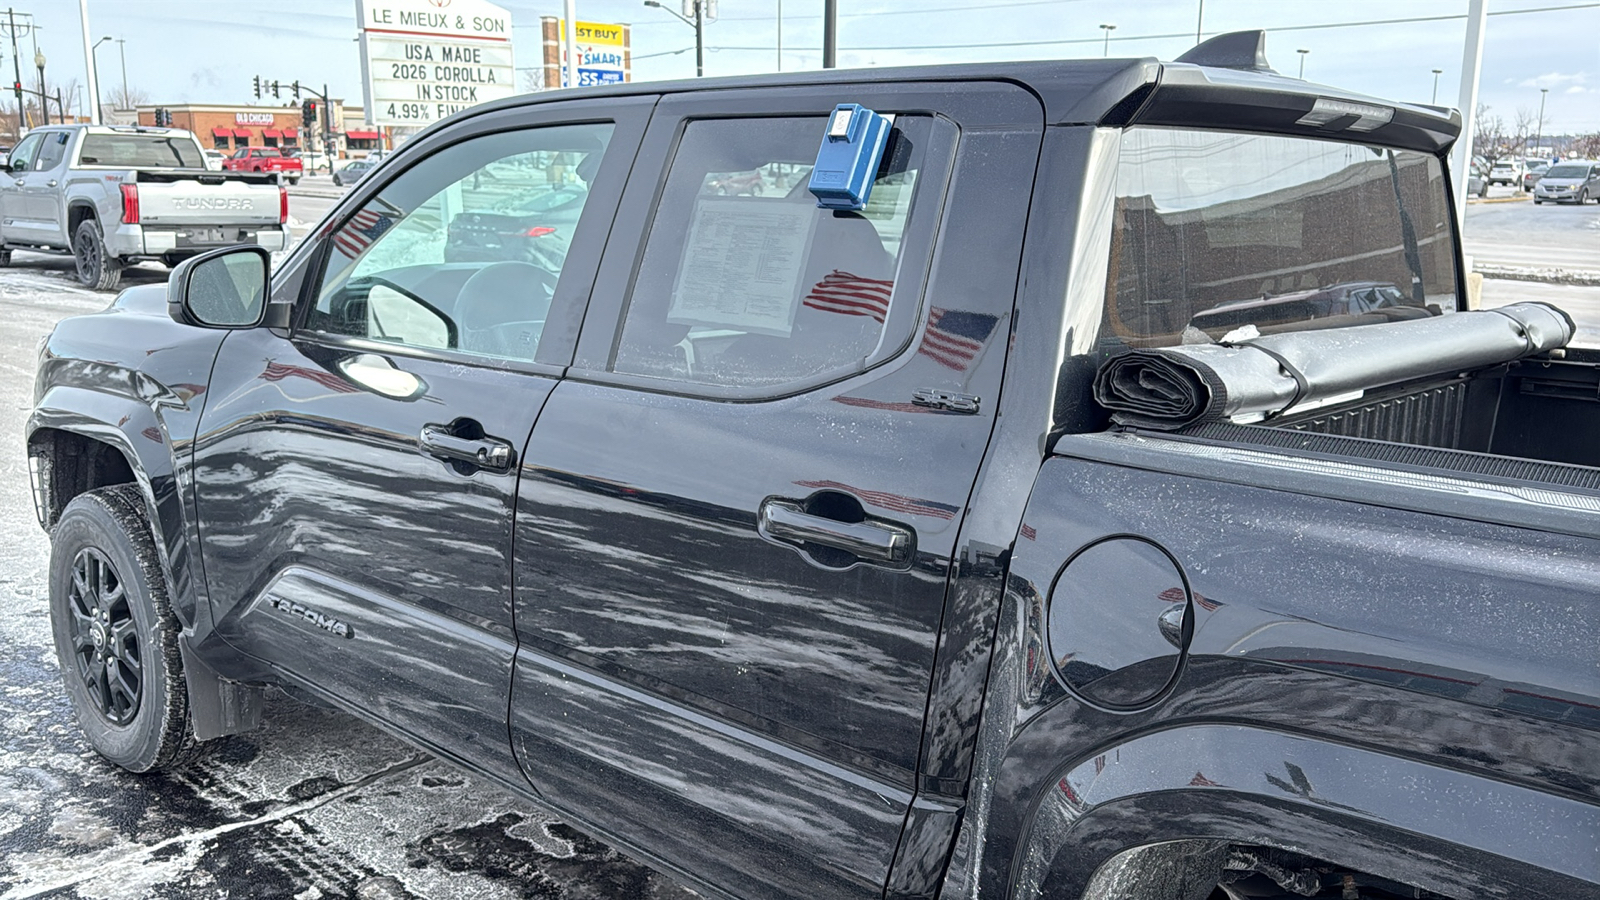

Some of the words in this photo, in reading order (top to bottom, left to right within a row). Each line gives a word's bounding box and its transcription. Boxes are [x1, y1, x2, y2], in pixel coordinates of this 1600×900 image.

[373, 8, 393, 24] LE
[400, 10, 448, 28] MIEUX
[455, 15, 465, 30] &
[473, 16, 504, 33] SON
[575, 27, 593, 38] EST
[594, 29, 619, 40] BUY
[405, 43, 434, 61] USA
[442, 46, 482, 64] MADE
[392, 63, 427, 80] 2026
[435, 65, 496, 84] COROLLA
[416, 84, 431, 100] IN
[435, 85, 478, 102] STOCK
[387, 103, 429, 119] 4.99%
[437, 104, 472, 119] FIN
[172, 197, 253, 210] TUNDRA
[266, 592, 354, 639] TACOMA
